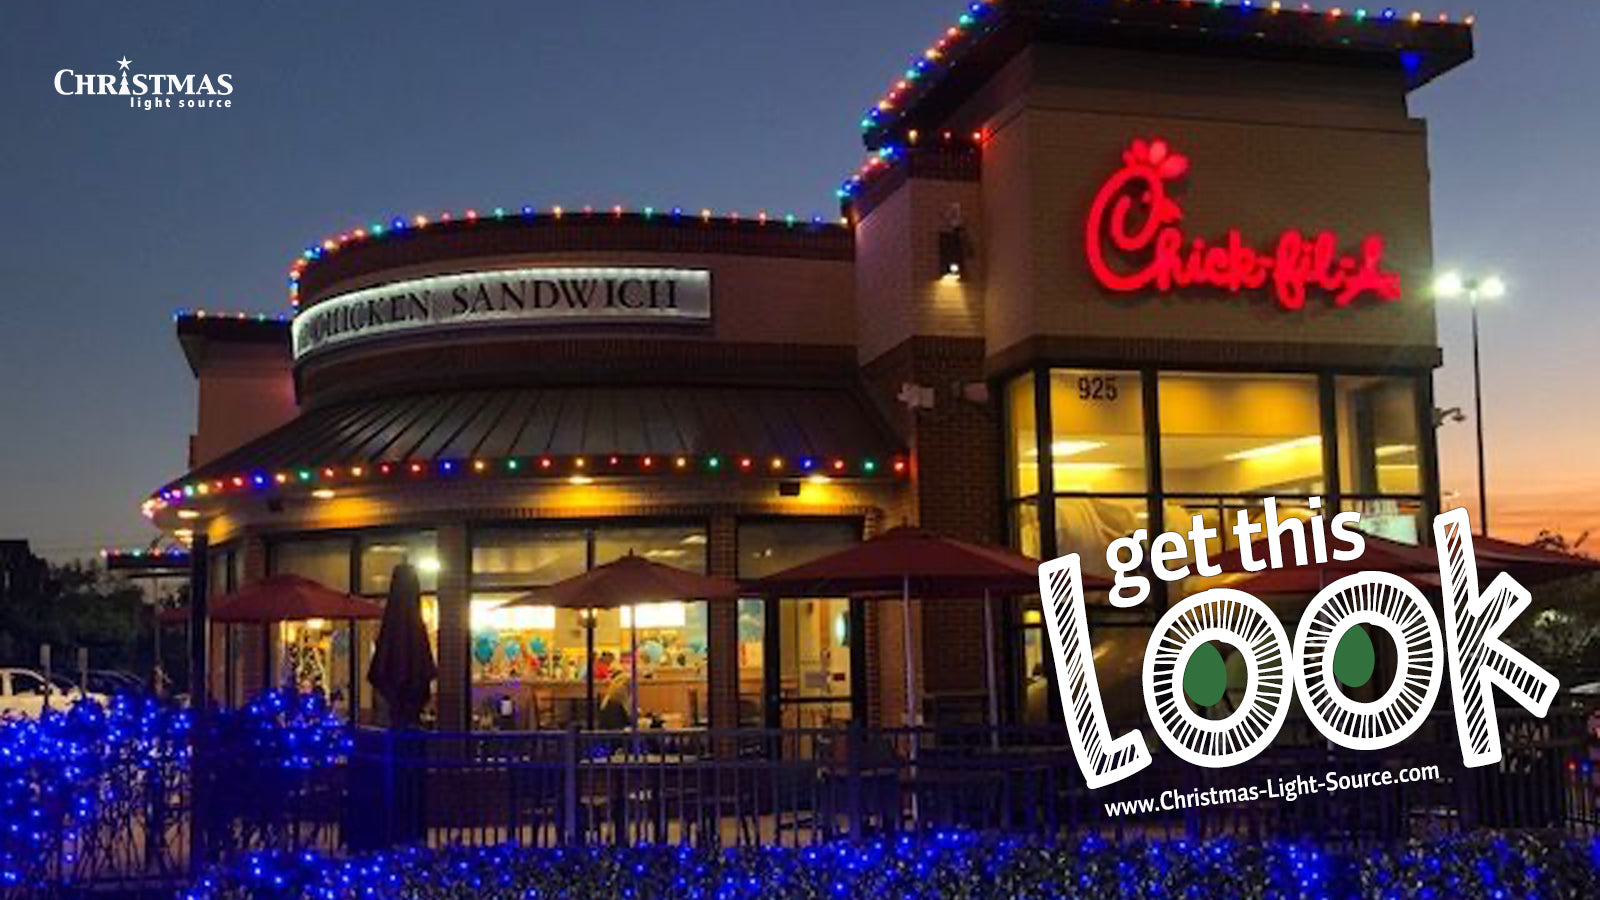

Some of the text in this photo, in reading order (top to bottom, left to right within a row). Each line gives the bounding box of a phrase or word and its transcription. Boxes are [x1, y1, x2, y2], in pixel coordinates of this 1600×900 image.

[1087, 139, 1400, 309] Chick-fil-A
[312, 290, 430, 340] CHICKEN
[451, 279, 678, 314] SANDWICH
[1078, 377, 1118, 401] 925
